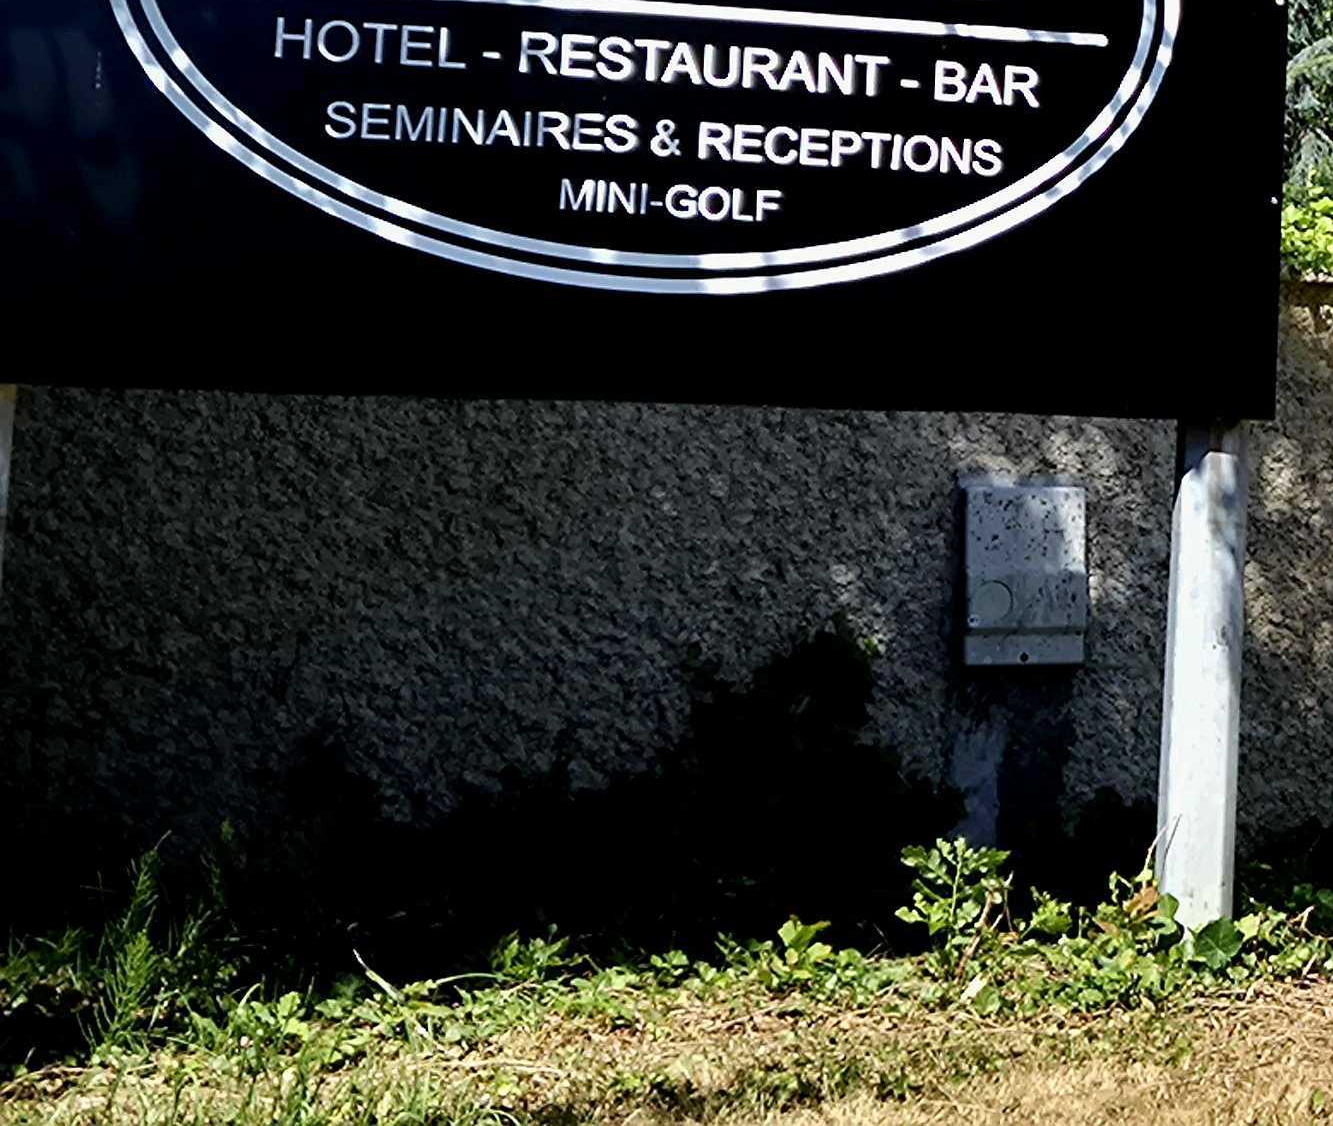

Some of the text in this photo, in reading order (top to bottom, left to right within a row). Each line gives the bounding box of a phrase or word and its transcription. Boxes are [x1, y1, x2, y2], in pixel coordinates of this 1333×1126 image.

[274, 17, 466, 69] HOTEL
[518, 31, 891, 97] RESTAURANT
[934, 60, 1040, 108] BAR
[325, 101, 1003, 176] SEMINAIRES & RECEPTIONS
[560, 178, 783, 222] MINI-GOLF
